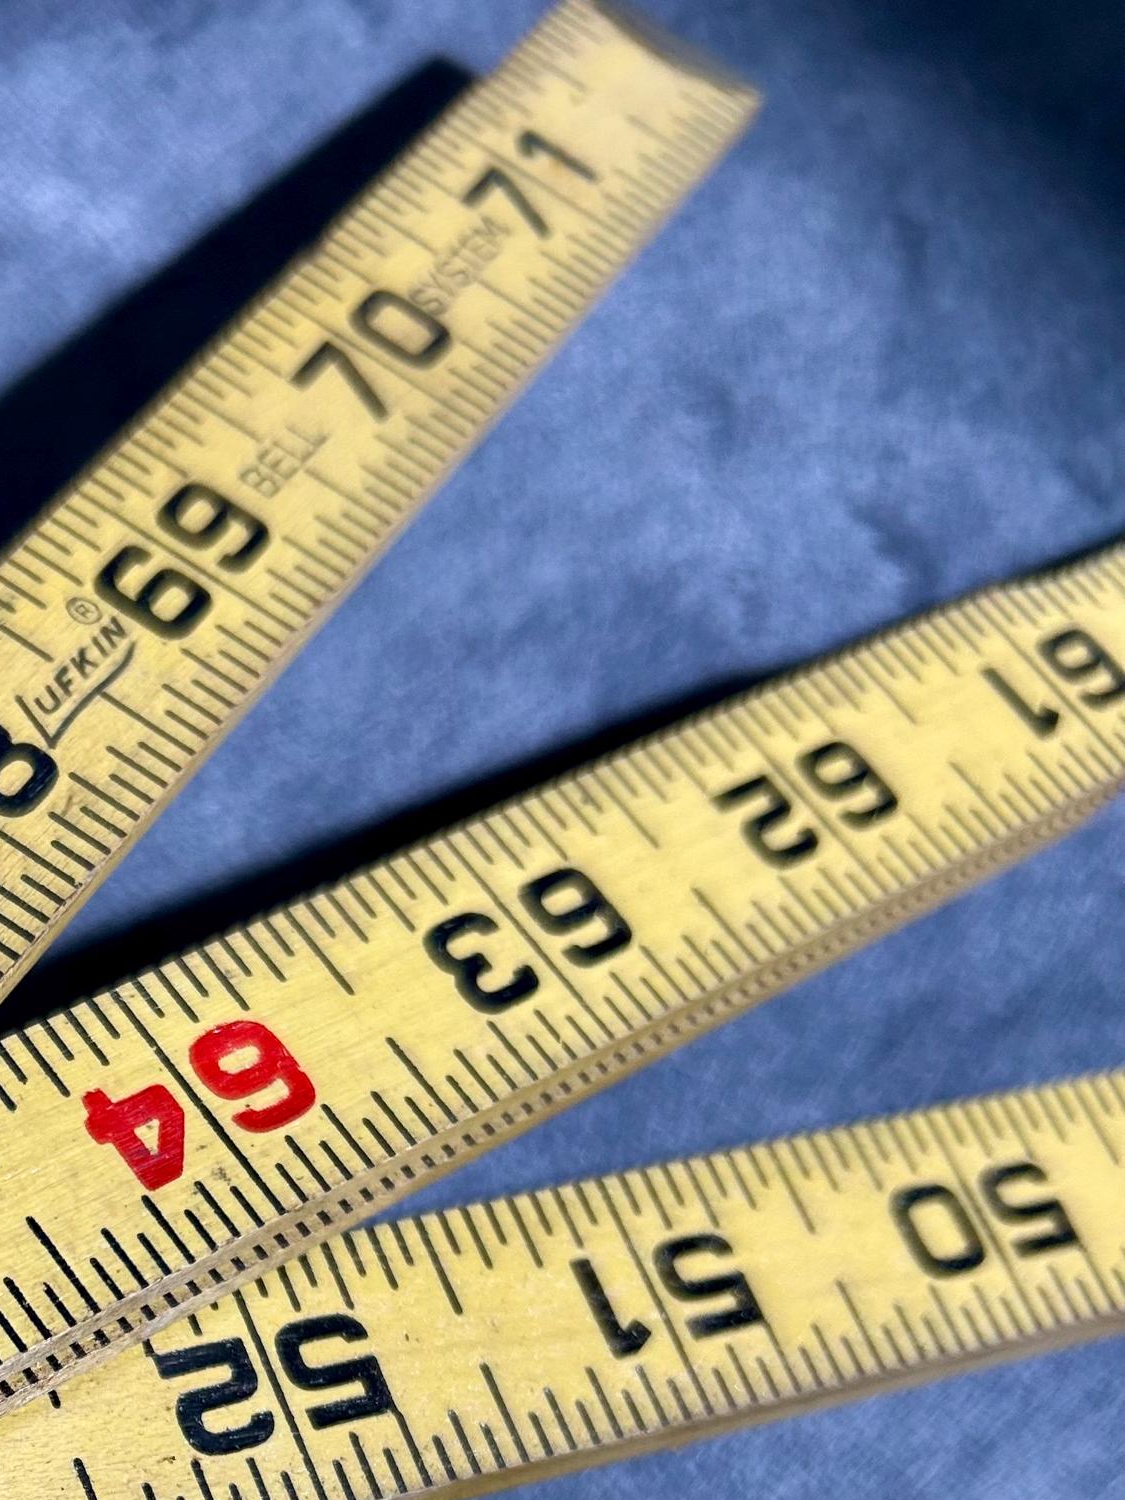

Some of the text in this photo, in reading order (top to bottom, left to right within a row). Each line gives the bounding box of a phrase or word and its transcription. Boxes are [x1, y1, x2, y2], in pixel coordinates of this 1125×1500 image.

[462, 128, 600, 241] 71
[409, 216, 513, 317] SYSTEM
[290, 289, 452, 423] 70
[240, 422, 328, 498] BELL
[93, 482, 271, 640] 69
[980, 622, 1125, 741] 61
[711, 740, 899, 870] 62
[422, 866, 634, 1015] 63
[82, 1020, 317, 1192] 64
[890, 1161, 1078, 1281] 50
[570, 1233, 764, 1359] 51
[151, 1313, 391, 1456] 52
